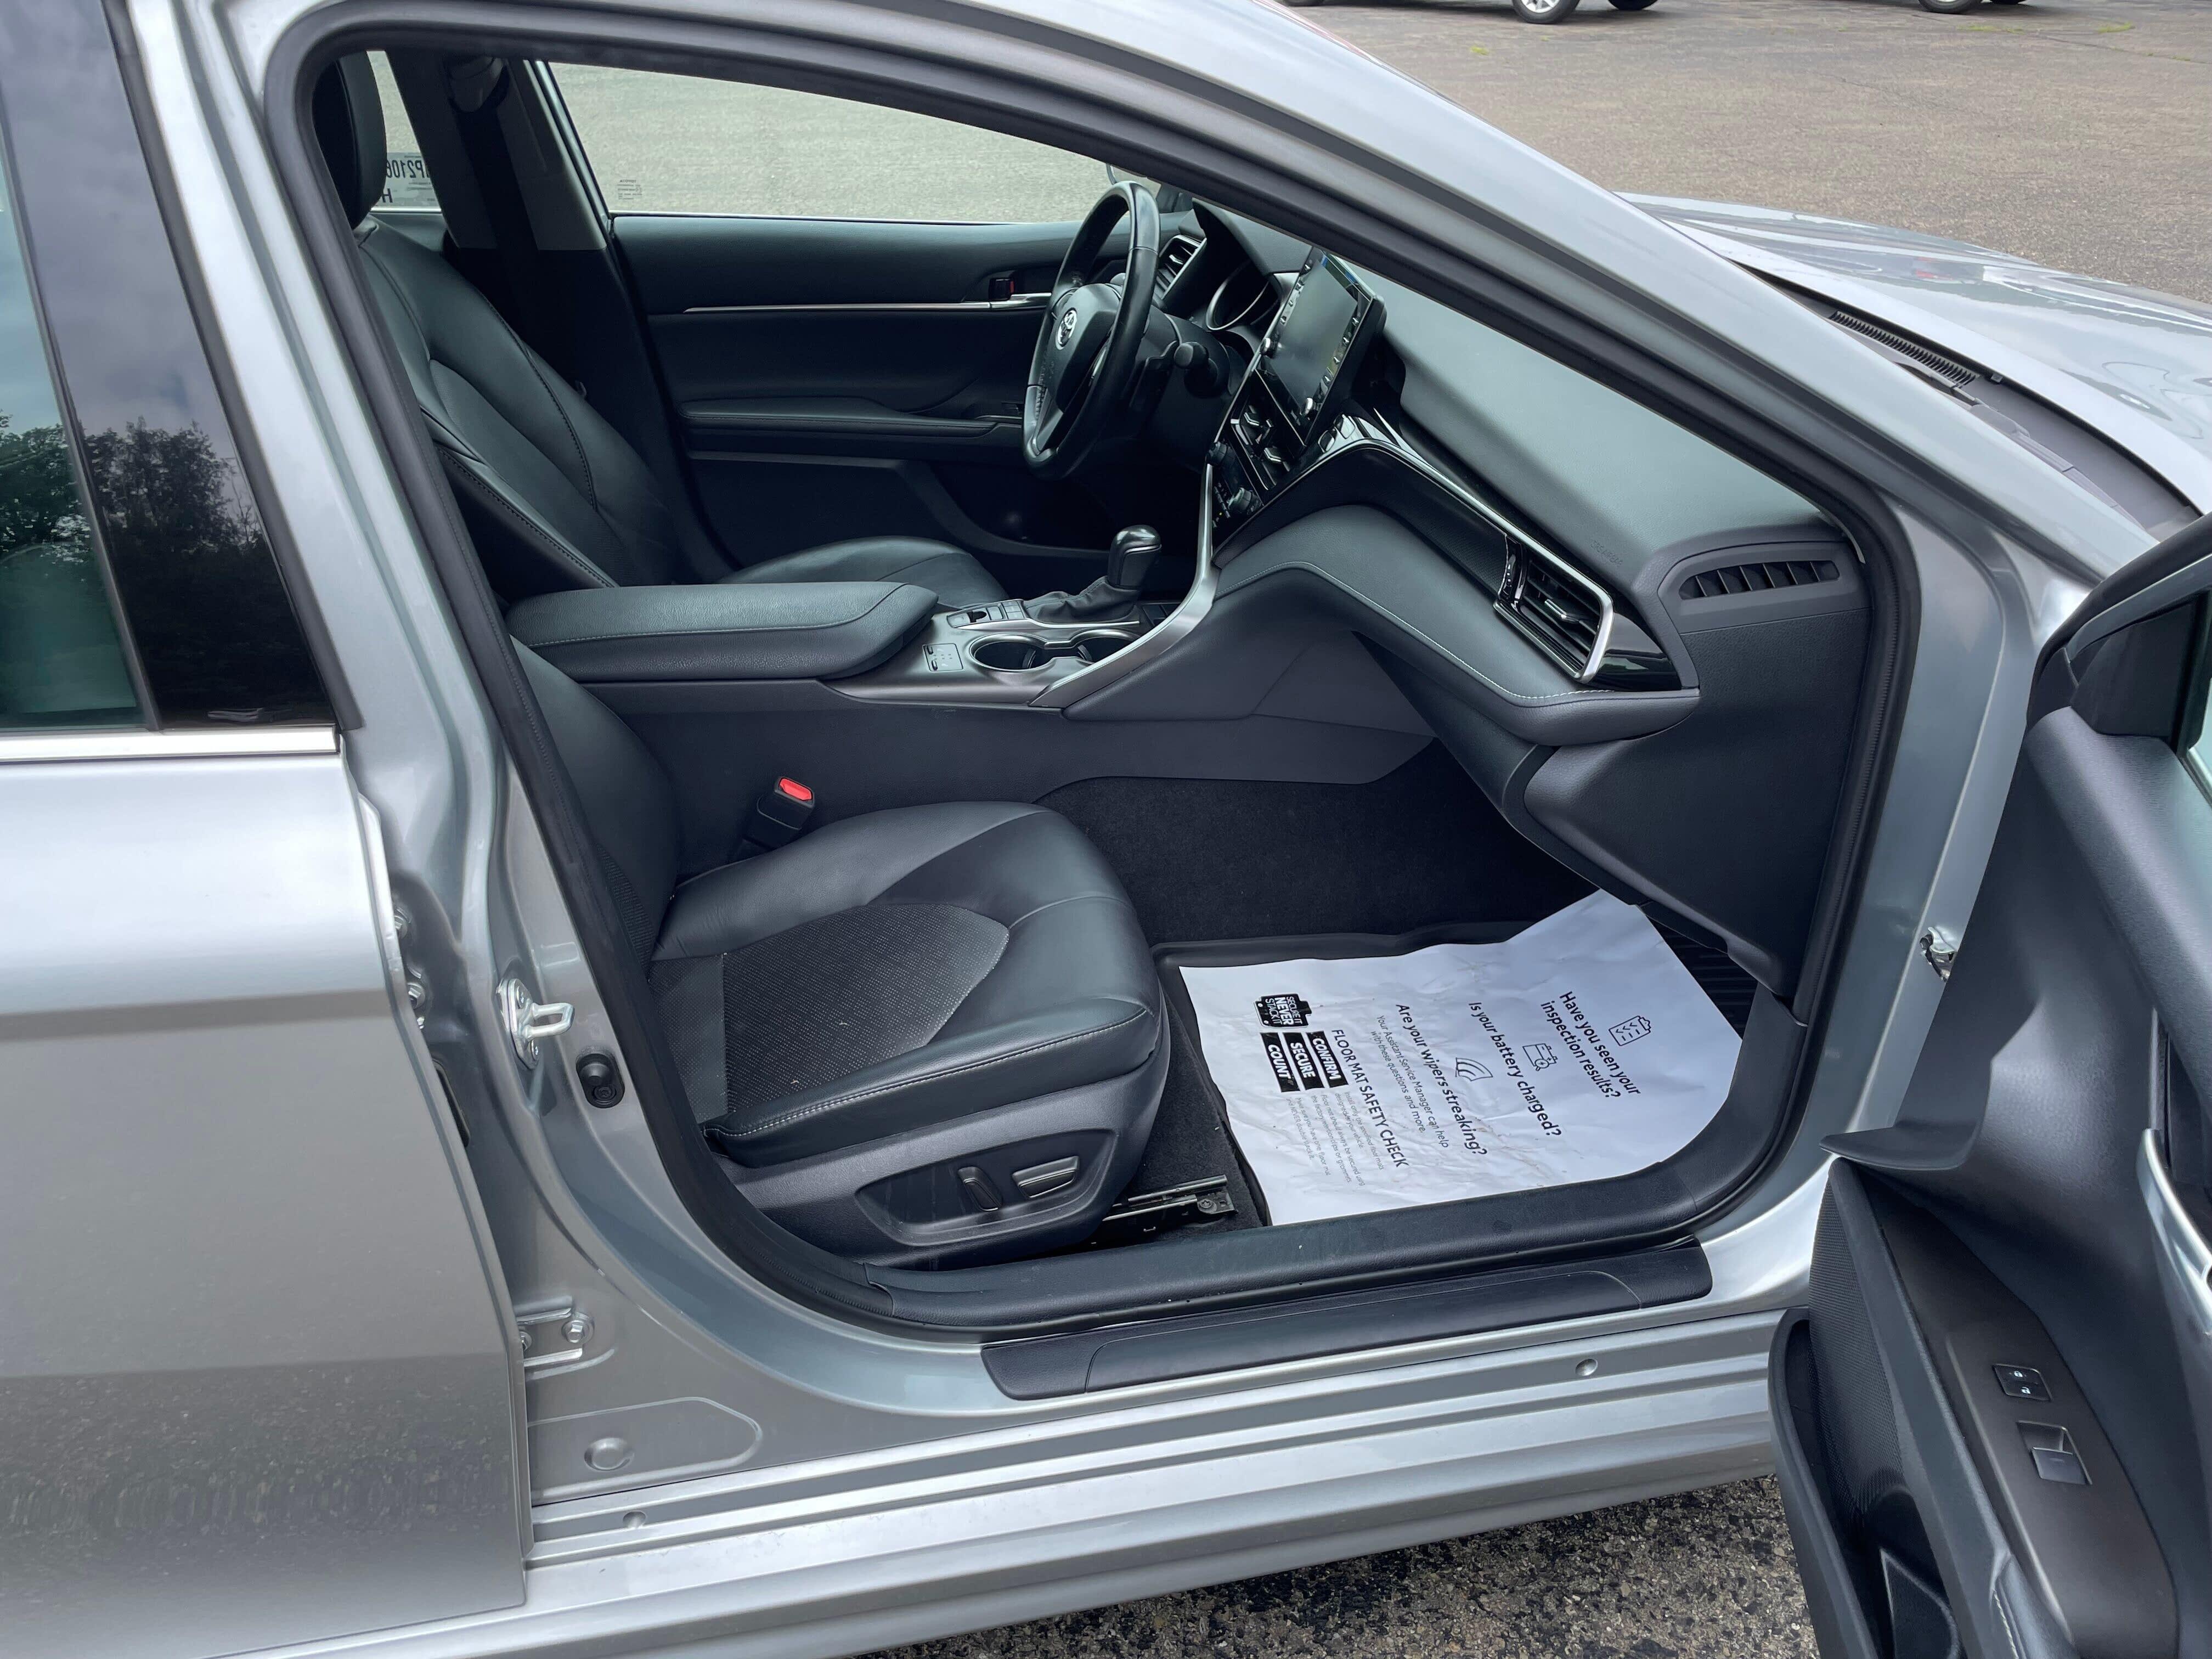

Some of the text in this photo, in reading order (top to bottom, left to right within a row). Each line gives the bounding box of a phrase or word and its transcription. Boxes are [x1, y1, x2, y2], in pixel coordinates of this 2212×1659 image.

[1265, 998, 1280, 1019] STACK
[1274, 997, 1295, 1025] NEVER
[1286, 996, 1301, 1019] SECURE
[1268, 1044, 1291, 1079] COUNT
[1290, 1042, 1316, 1078] SECURE
[1312, 1038, 1341, 1080] CONFIRM
[1541, 1000, 1621, 1098] inspection results?
[1559, 991, 1641, 1095] Have you seen your
[1370, 1031, 1426, 1133] with these questions and more.
[1376, 1015, 1449, 1148] Your Assistant Service Manager can help
[1396, 1004, 1488, 1155] Are your wipers streaking?
[1469, 1002, 1562, 1136] Is your battery charged?
[1331, 1029, 1409, 1167] FLOOR MAT SAFETY CHECK
[1351, 1105, 1360, 1116] only
[1290, 1107, 1301, 1122] NEVER
[1296, 1123, 1307, 1140] double
[1346, 1121, 1356, 1132] your
[1330, 1116, 1342, 1130] should
[1347, 1155, 1361, 1175] secured
